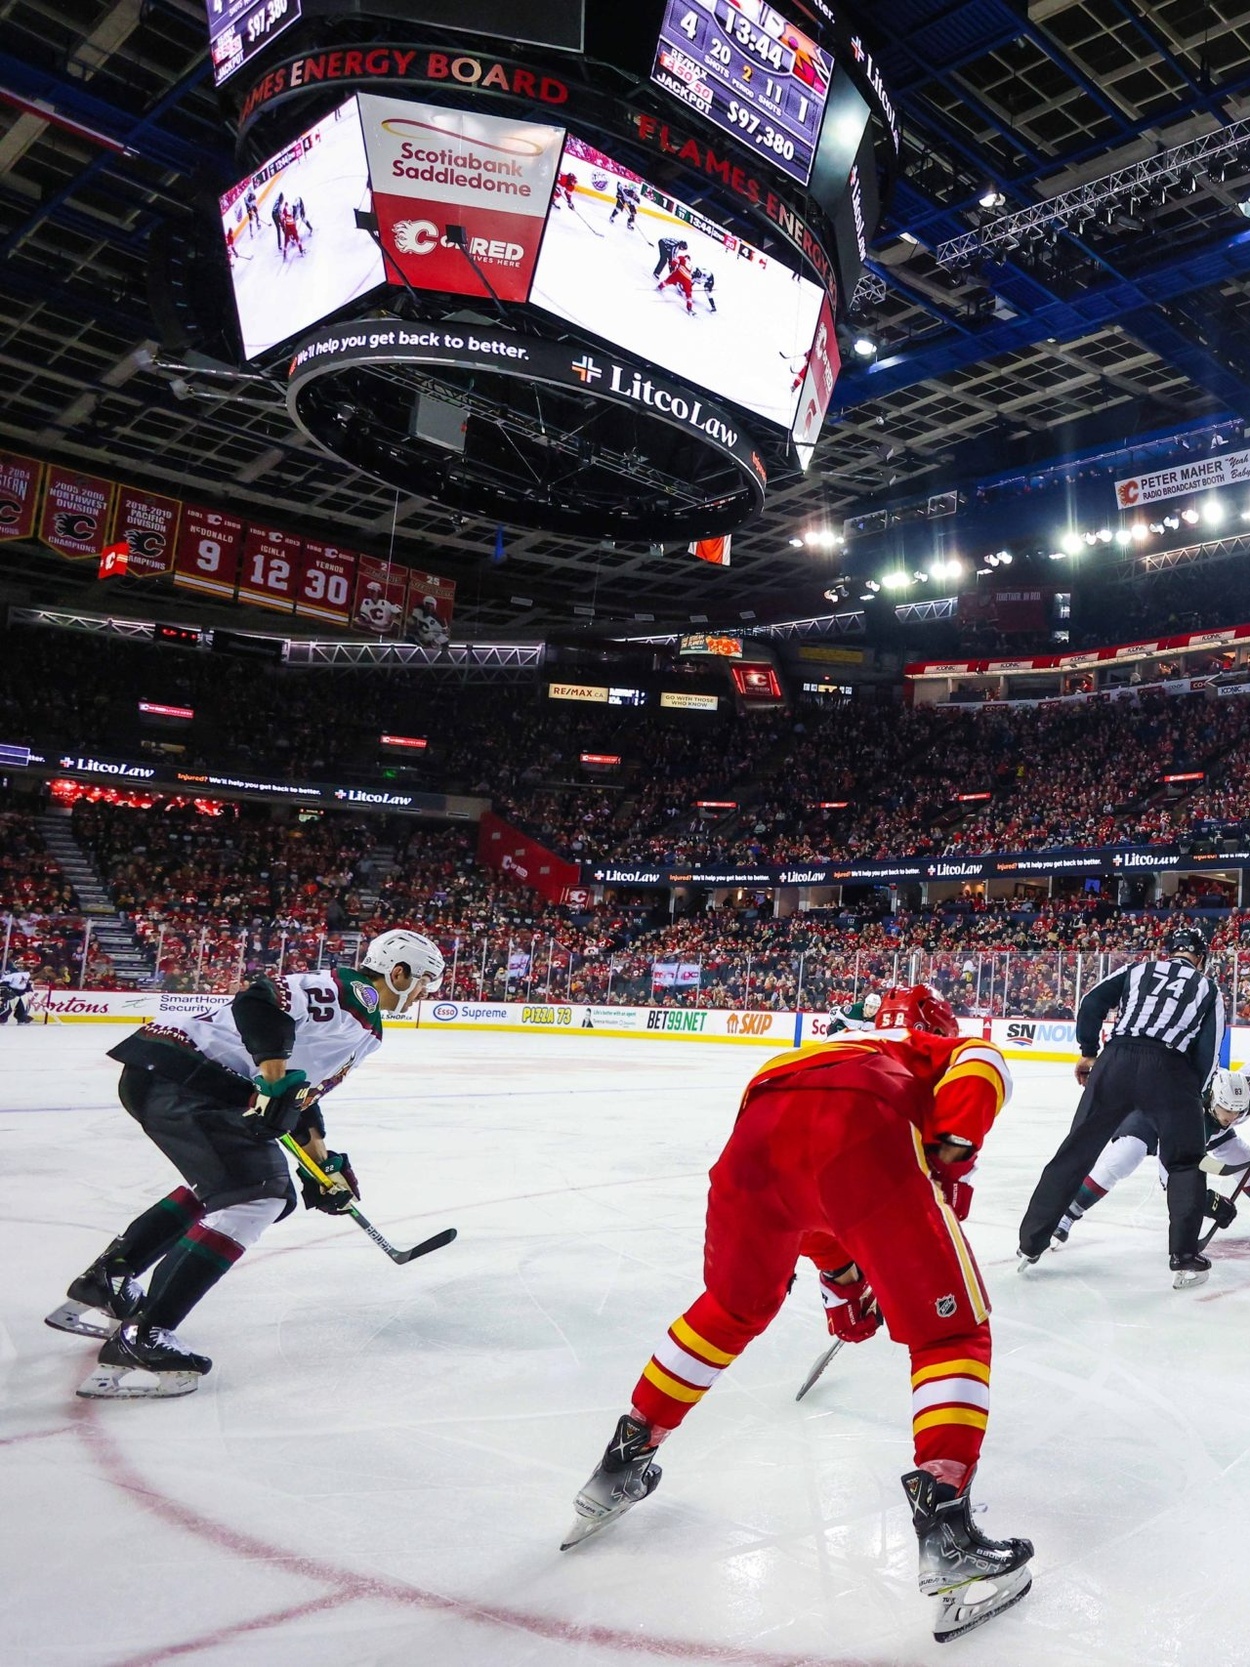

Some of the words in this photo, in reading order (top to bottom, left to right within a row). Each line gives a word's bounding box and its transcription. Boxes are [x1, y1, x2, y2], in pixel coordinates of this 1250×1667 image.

[681, 11, 698, 40] 4
[724, 7, 783, 70] 13:44
[711, 39, 731, 65] 20
[290, 49, 416, 87] ENERGY
[426, 57, 569, 104] BOARD
[704, 55, 730, 79] SHOTS
[742, 65, 753, 82] 2
[656, 71, 713, 115] JACKPOT
[765, 78, 783, 103] 11
[758, 94, 782, 117] SHOTS
[798, 97, 808, 122] 1
[727, 100, 795, 161] $97,380
[401, 142, 523, 178] Scotiabank
[635, 112, 760, 203] FLAMES
[392, 160, 532, 197] Saddledome
[316, 338, 340, 356] help
[341, 336, 366, 353] you
[370, 332, 395, 349] get
[399, 331, 440, 346] back
[444, 334, 464, 349] to
[468, 336, 530, 361] better.
[609, 364, 739, 449] LitcoLaw
[1140, 471, 1179, 490] PETER
[1180, 460, 1223, 481] MAHER
[1143, 488, 1163, 501] RADIO
[1163, 479, 1202, 496] BROADCAST
[1202, 474, 1226, 486] BOOTH
[56, 498, 100, 517] DIVISION
[196, 539, 222, 572] 9
[250, 554, 291, 592] 12
[304, 568, 349, 606] 30
[553, 686, 593, 697] RE/MAX
[77, 759, 154, 778] LitcoLaw
[244, 781, 258, 790] you
[259, 783, 271, 791] get
[272, 783, 289, 792] back
[349, 790, 412, 806] LitcoLaw
[606, 870, 659, 883] LitcoLaw
[787, 871, 825, 883] LitcoLaw
[937, 863, 982, 876] LitcoLaw
[1151, 971, 1185, 997] 74
[159, 1003, 212, 1014] Security
[161, 994, 231, 1005] SmartHom
[305, 987, 336, 1023] 22
[461, 1006, 507, 1020] Supreme
[521, 1006, 555, 1025] PIZZA
[557, 1008, 572, 1026] 73
[647, 1010, 708, 1032] BET99.NET
[739, 1013, 773, 1036] SKIP
[883, 1012, 905, 1028] 58
[1007, 1024, 1037, 1040] SN
